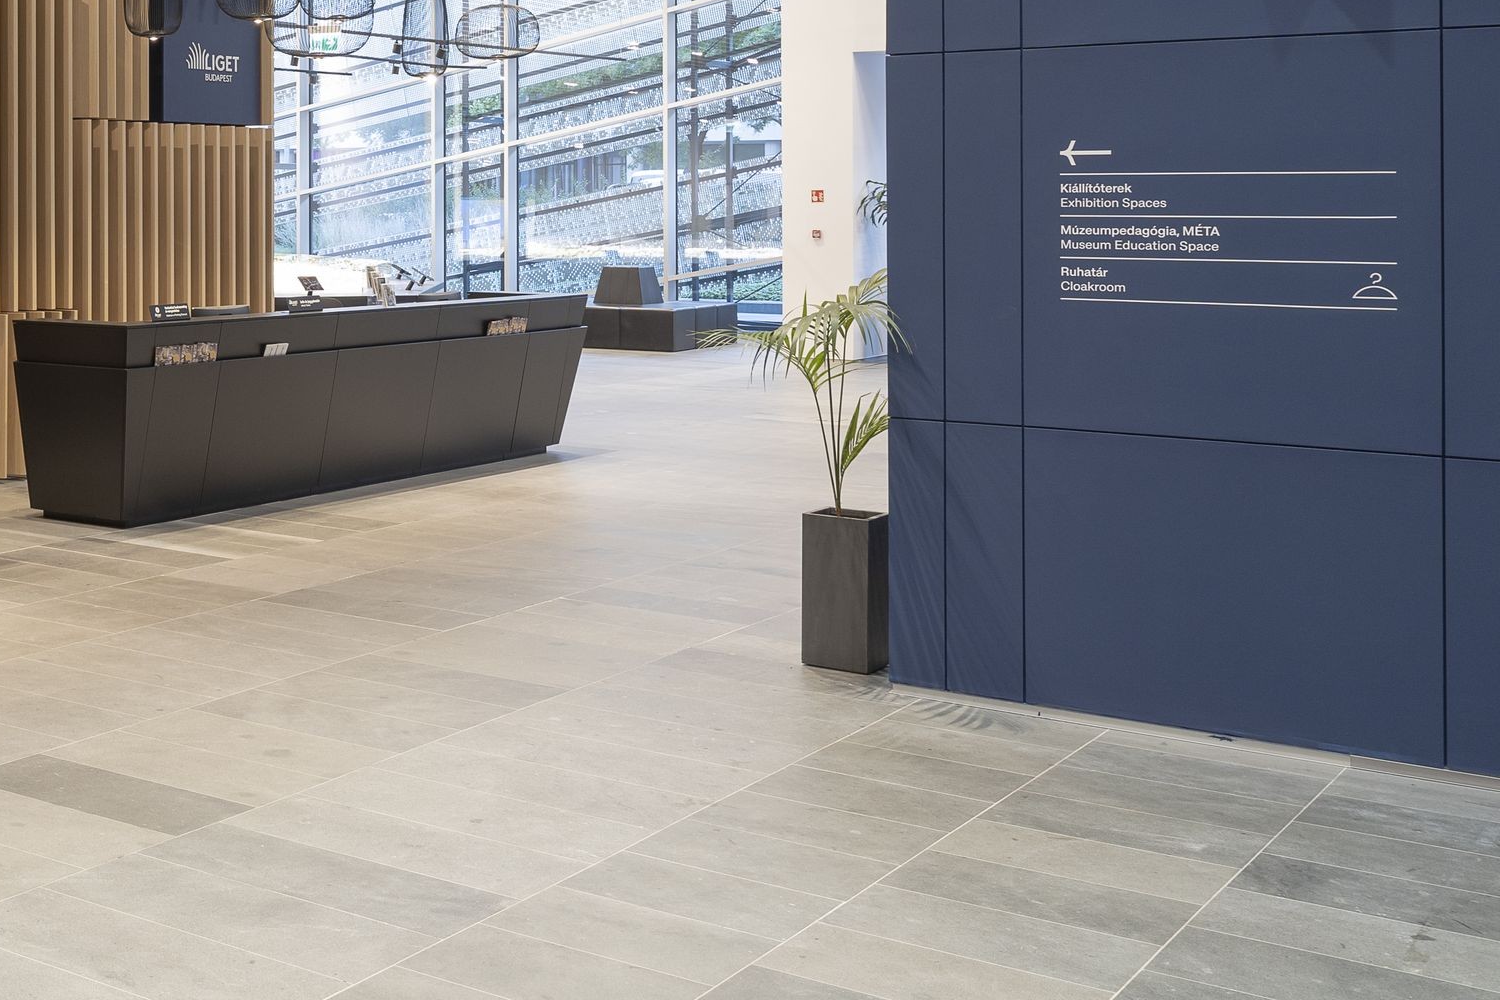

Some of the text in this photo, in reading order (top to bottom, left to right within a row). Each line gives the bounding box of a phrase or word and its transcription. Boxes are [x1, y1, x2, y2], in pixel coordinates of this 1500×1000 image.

[205, 53, 239, 72] LIGET
[205, 74, 232, 82] BUDAPEST
[1060, 183, 1132, 194] Kiállítóterek
[1060, 197, 1167, 210] Exhibition Spaces
[1060, 223, 1221, 238] Múzeumpedagógia, MÉTA
[1060, 239, 1219, 253] Museum Education Space
[1060, 266, 1108, 277] Ruhatár
[1060, 280, 1126, 292] Cloakroom
